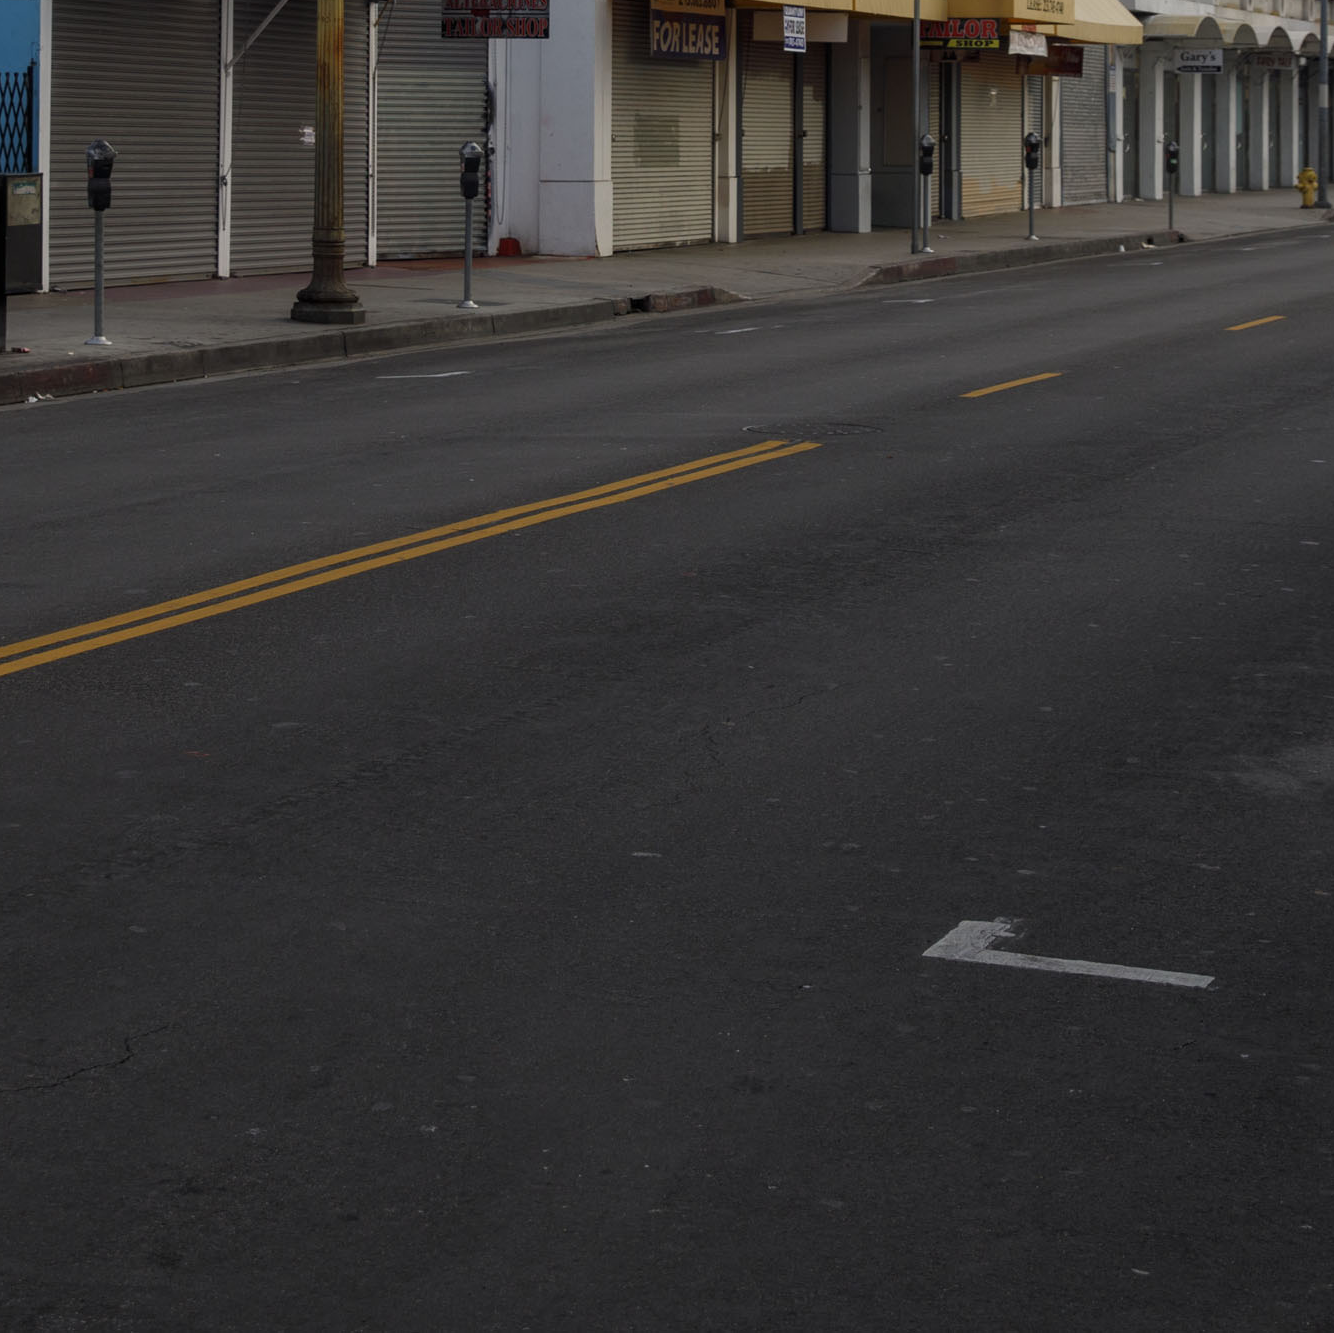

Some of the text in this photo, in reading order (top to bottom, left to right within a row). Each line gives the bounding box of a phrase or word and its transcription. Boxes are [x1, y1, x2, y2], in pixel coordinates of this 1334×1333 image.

[506, 17, 548, 38] SHOP
[653, 20, 720, 55] FOR LEASE
[955, 39, 994, 47] SHOP
[1180, 52, 1216, 64] Gary's
